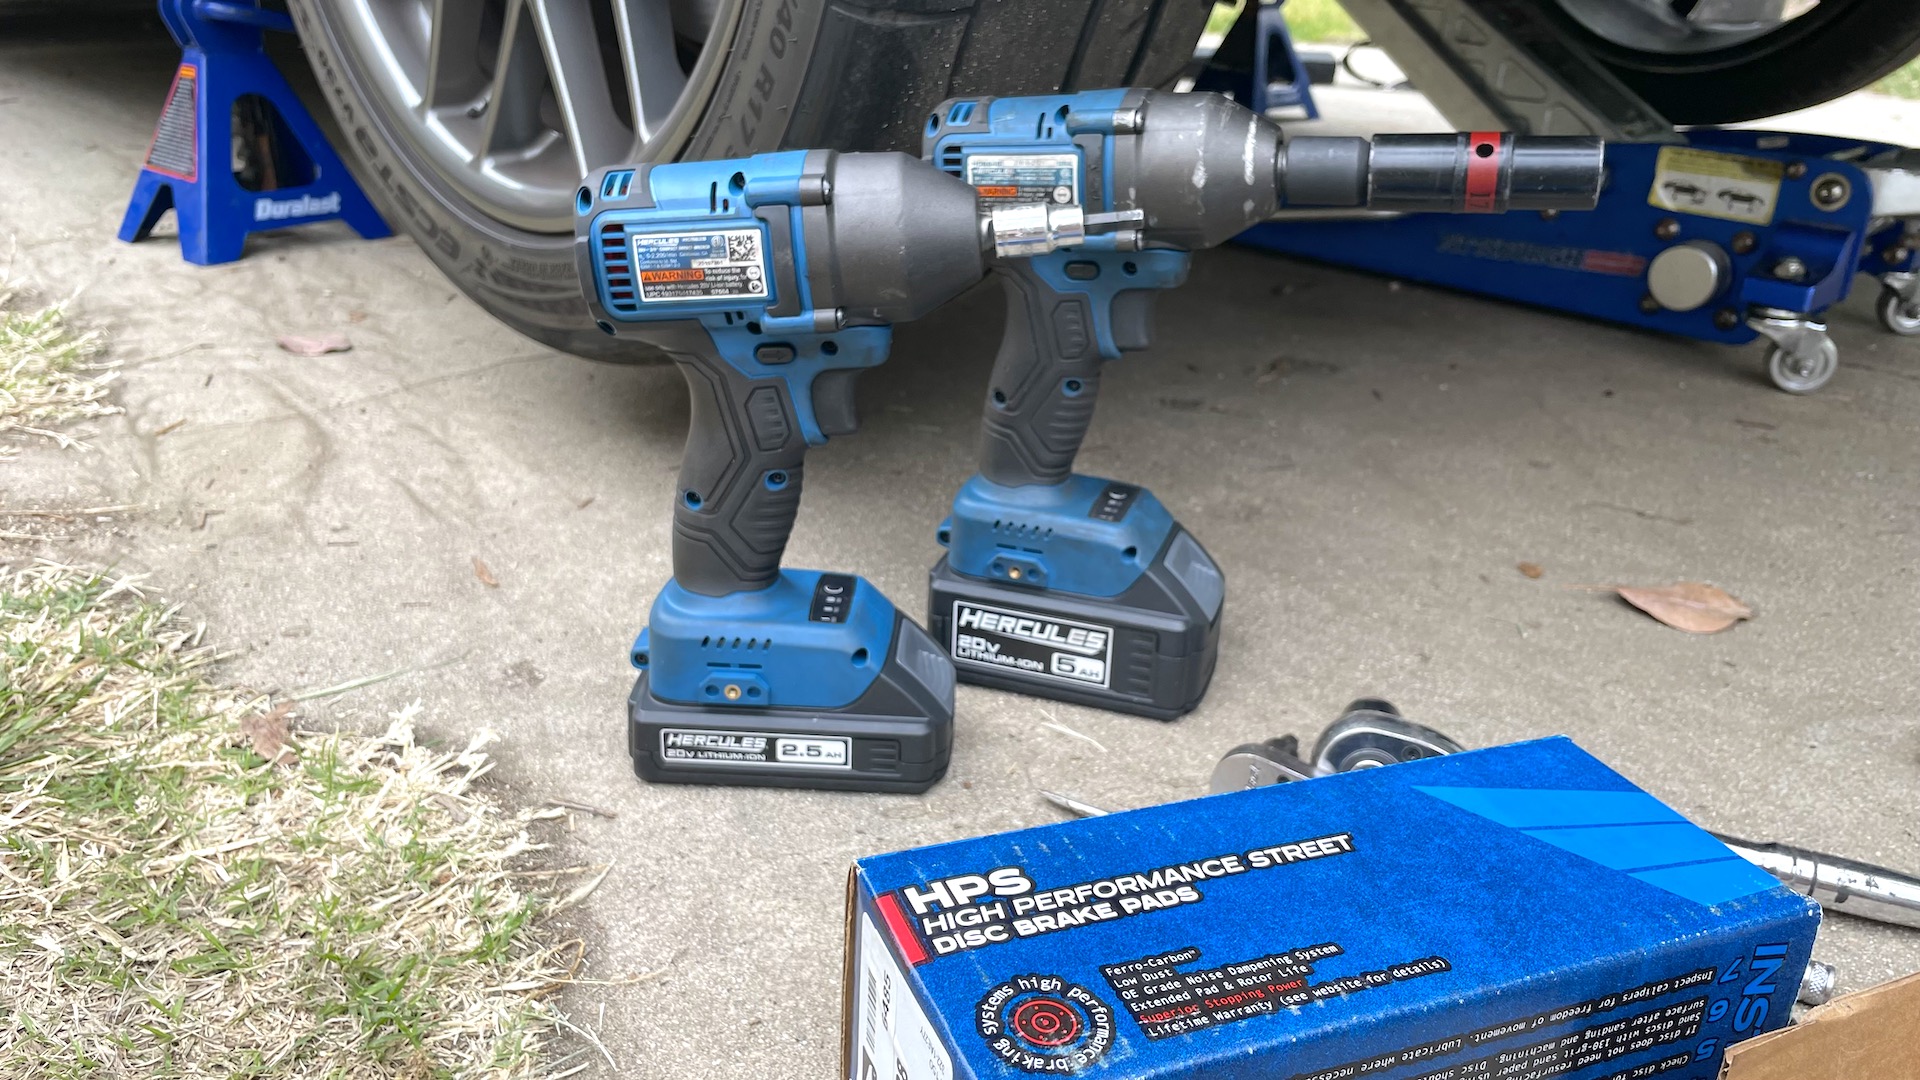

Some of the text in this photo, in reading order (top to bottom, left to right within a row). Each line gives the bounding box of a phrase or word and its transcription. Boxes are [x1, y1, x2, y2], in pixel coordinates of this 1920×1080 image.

[255, 193, 341, 221] Duralast
[652, 271, 702, 280] WARNING
[959, 607, 1107, 650] HERCULES
[958, 634, 1000, 653] 20V
[957, 648, 1044, 672] LITHIUM-ION
[1057, 658, 1077, 673] 5
[667, 733, 767, 750] HERCULES
[782, 744, 822, 758] 2.5
[666, 750, 767, 761] 20V LITHIUM-ION
[906, 868, 1031, 913] HPS
[923, 834, 1353, 935] HIGH PERFORMANCE STREET
[932, 887, 1200, 955] DISC BRAKE PADS
[1114, 968, 1173, 988] Low Dust
[1122, 945, 1338, 999] OE Grade Noise Dampening System
[1674, 970, 1714, 988] Inspect
[1720, 957, 1744, 984] 7
[1131, 964, 1308, 1011] Extended Pad & Rotor Life
[1622, 983, 1669, 1001] calipers
[1733, 944, 1788, 1036] INS
[1140, 978, 1302, 1023] Superior Stopping Power
[1148, 959, 1447, 1037] Lifetime Warranty (see website for details)
[1599, 997, 1616, 1008] for
[1550, 1003, 1592, 1021] freedom
[1665, 999, 1705, 1016] surface
[1708, 999, 1729, 1022] 6
[981, 977, 1110, 1072] high performance braking systems
[1531, 1014, 1544, 1027] of
[1631, 1011, 1660, 1026] after
[1645, 1020, 1673, 1034] discs
[1678, 1012, 1702, 1026] Sand
[1470, 1022, 1526, 1042] movement.
[1584, 1020, 1626, 1040] sanding
[1616, 1026, 1641, 1041] with
[1658, 1029, 1681, 1042] disc
[1685, 1024, 1698, 1036] If
[1560, 1033, 1580, 1047] and
[1630, 1037, 1653, 1050] does
[1401, 1039, 1462, 1061] Lubricate
[1494, 1043, 1556, 1064] machining.
[1578, 1051, 1602, 1066] need
[1608, 1045, 1625, 1058] not
[1694, 1037, 1720, 1062] 5
[1360, 1056, 1395, 1072] where
[1461, 1060, 1488, 1073] Disc
[1496, 1059, 1528, 1077] paper
[1532, 1052, 1557, 1067] sand
[1660, 1055, 1689, 1070] Check
[1632, 1064, 1656, 1077] disc
